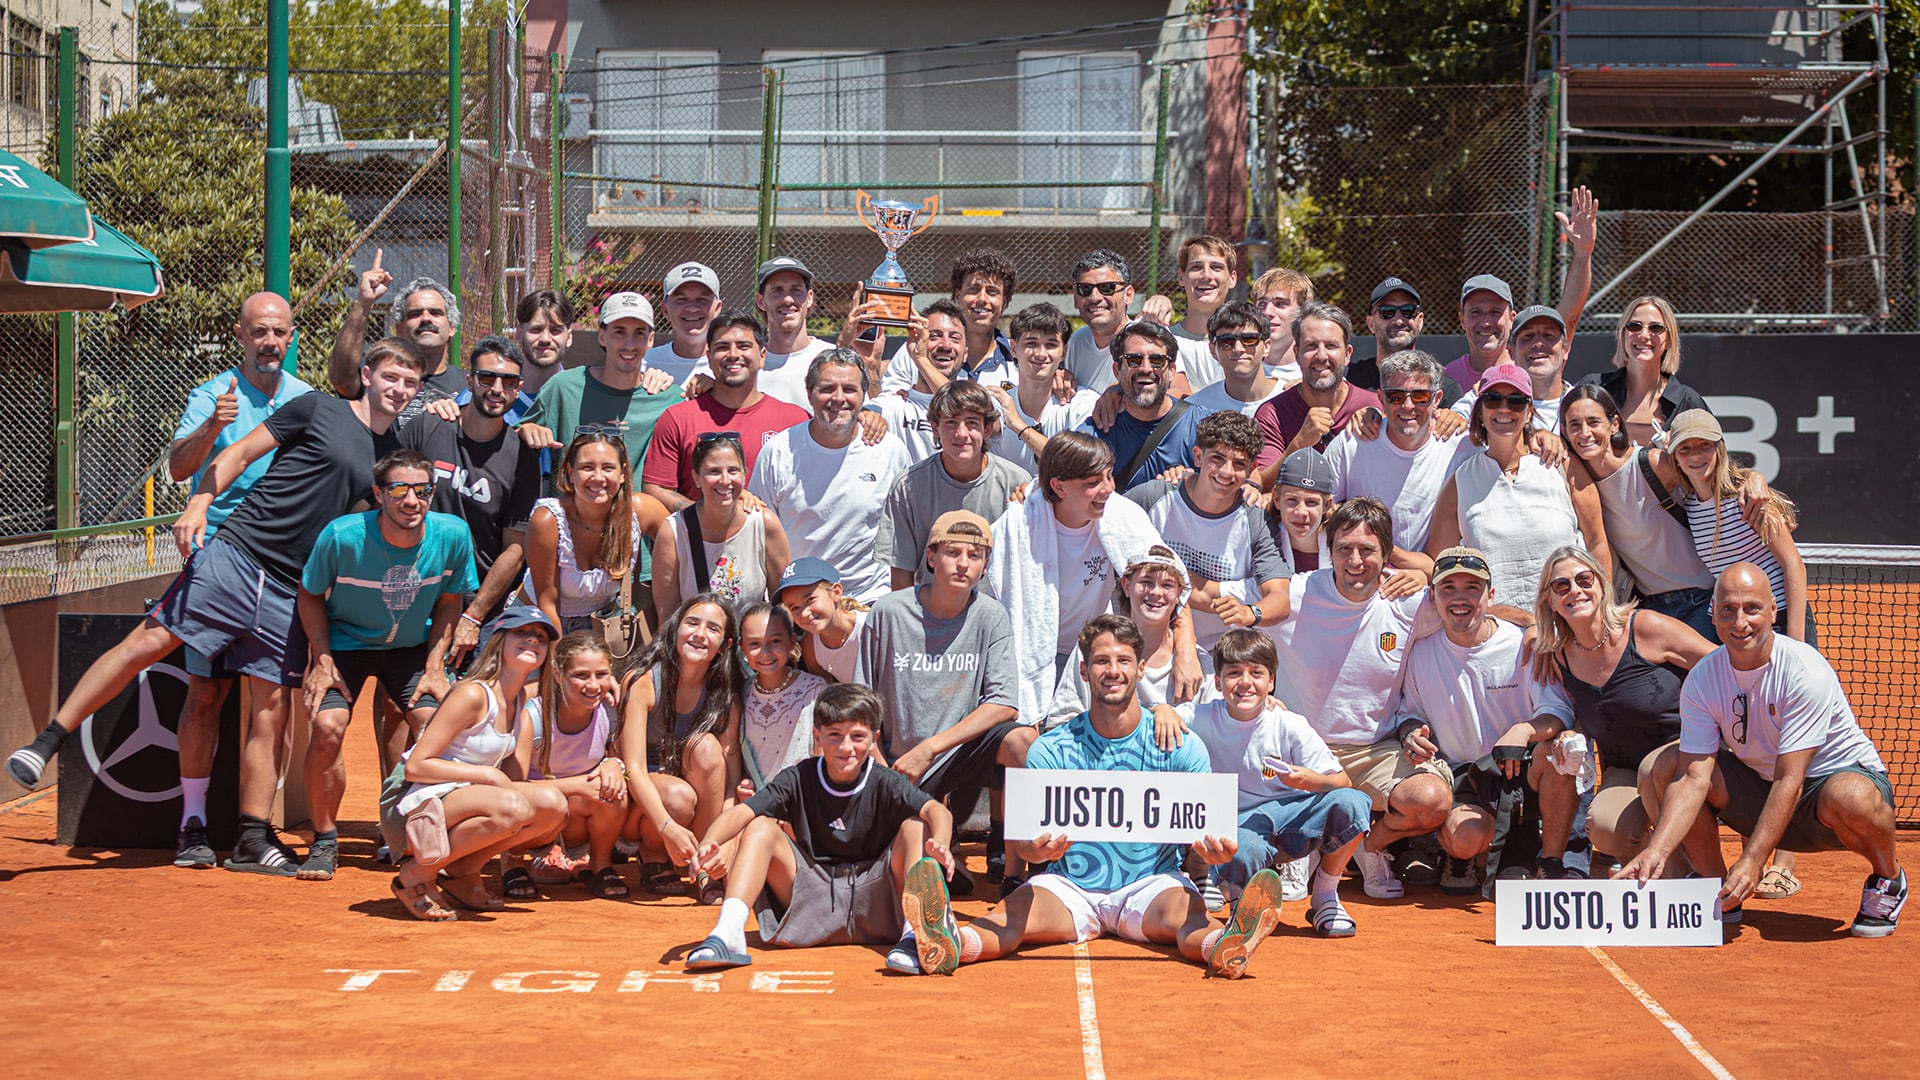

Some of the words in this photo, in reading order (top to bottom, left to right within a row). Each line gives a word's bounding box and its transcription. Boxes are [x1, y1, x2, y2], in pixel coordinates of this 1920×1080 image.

[433, 460, 491, 503] FILA
[912, 653, 943, 672] ZOO
[1040, 785, 1133, 833] JUSTO,
[1143, 787, 1161, 829] G
[1169, 802, 1207, 830] ARG
[1521, 890, 1613, 934] JUSTO,
[1622, 890, 1639, 930] G
[1648, 891, 1657, 929] I
[1666, 902, 1702, 929] ARG
[323, 969, 835, 994] TIGRE
